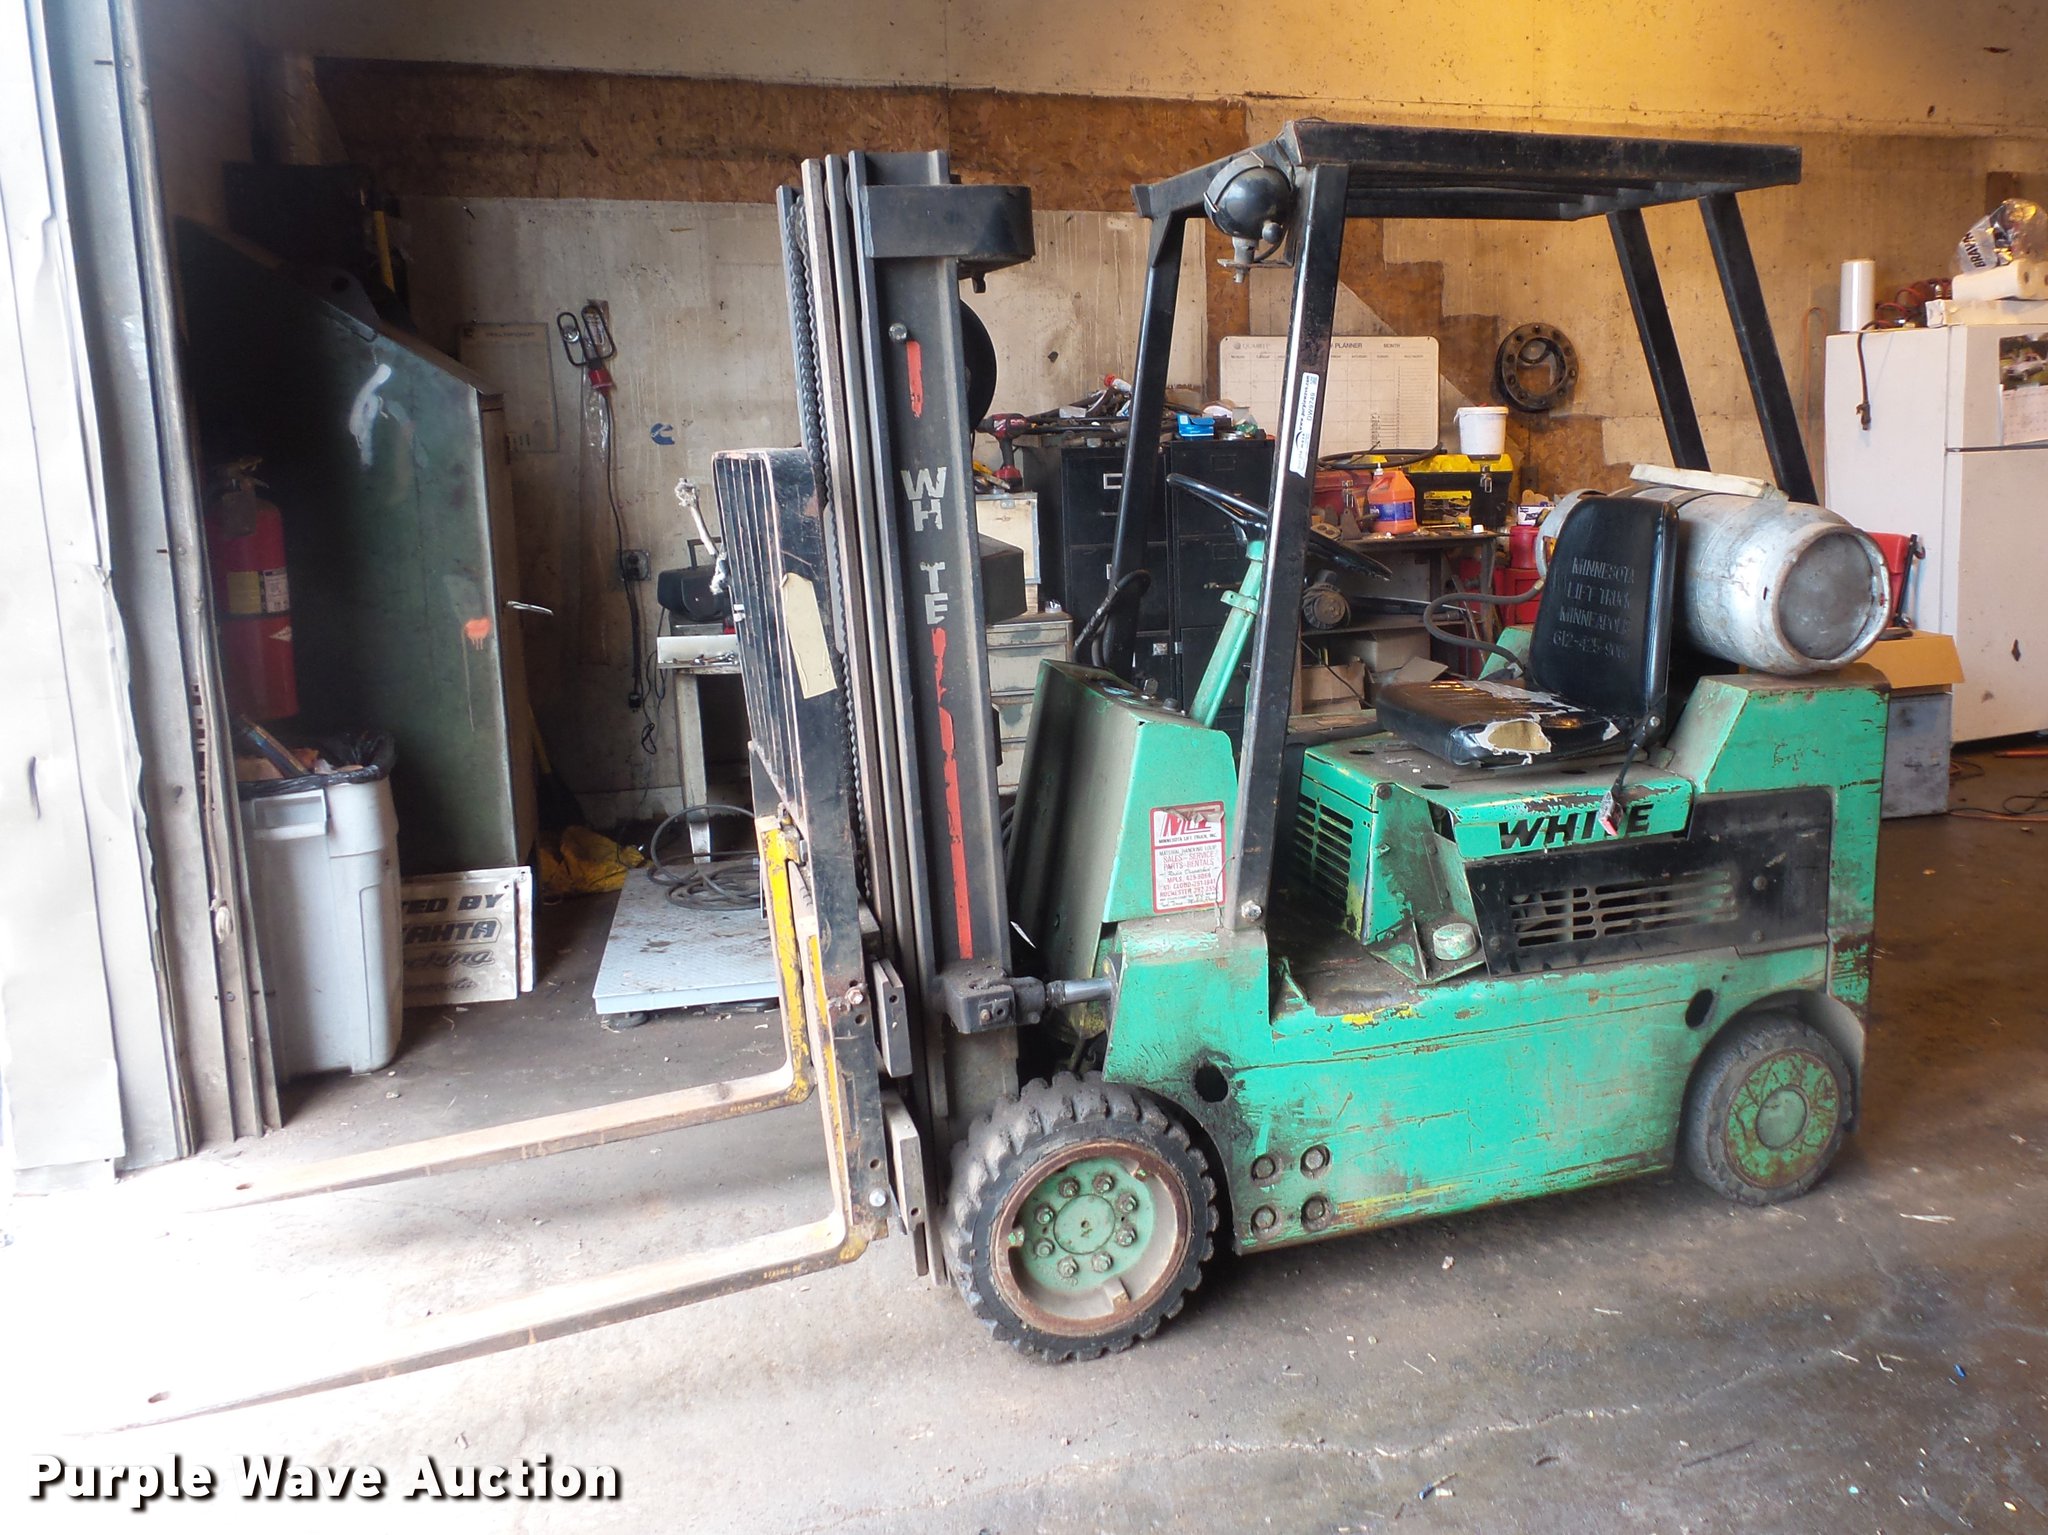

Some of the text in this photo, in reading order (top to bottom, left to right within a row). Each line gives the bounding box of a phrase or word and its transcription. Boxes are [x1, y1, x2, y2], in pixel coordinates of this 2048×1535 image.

[901, 466, 949, 625] WHTE
[1571, 556, 1635, 583] MINNESOTA
[1499, 803, 1655, 851] WHIE
[458, 894, 504, 910] BY
